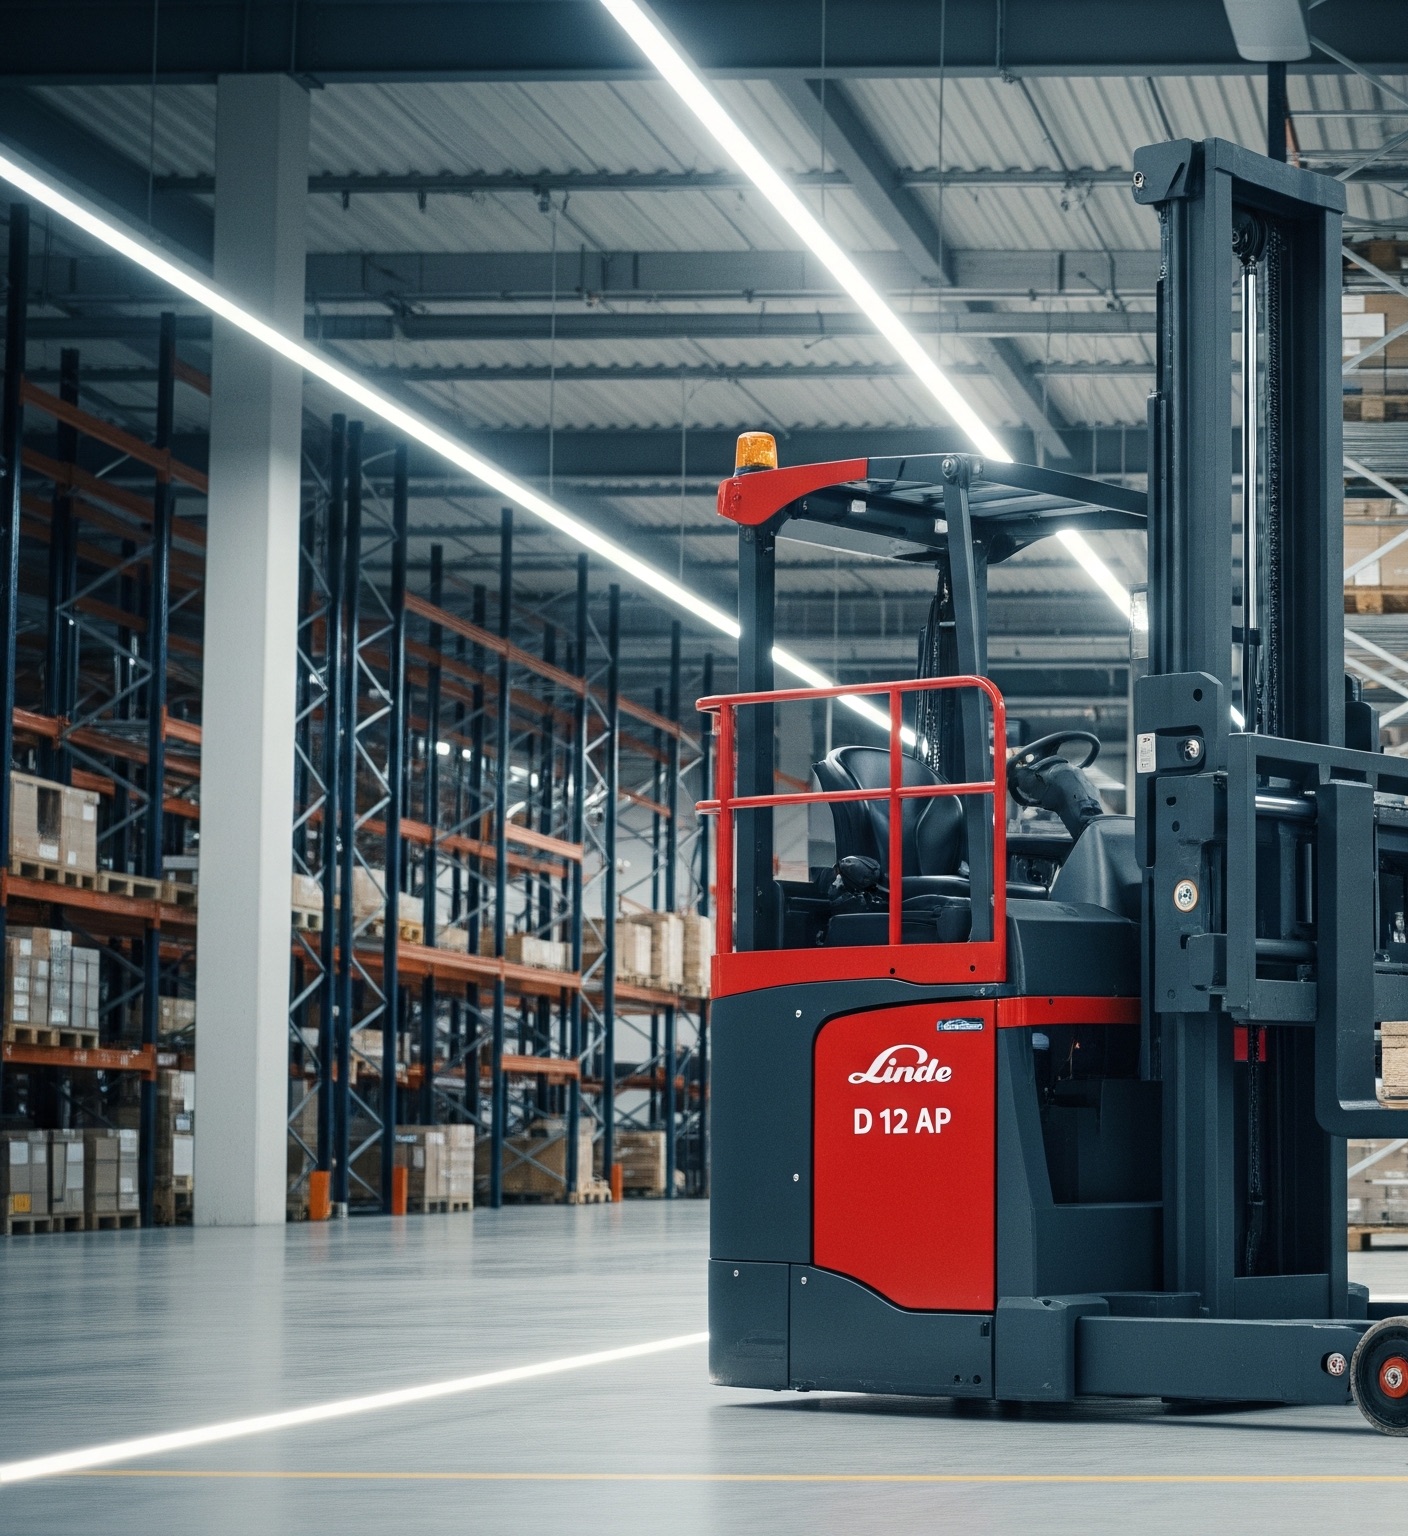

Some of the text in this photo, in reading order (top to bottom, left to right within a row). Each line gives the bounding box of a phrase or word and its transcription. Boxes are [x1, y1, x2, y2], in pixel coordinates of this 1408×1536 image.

[848, 1044, 952, 1084] Linde
[854, 1107, 951, 1134] D 12 AP
